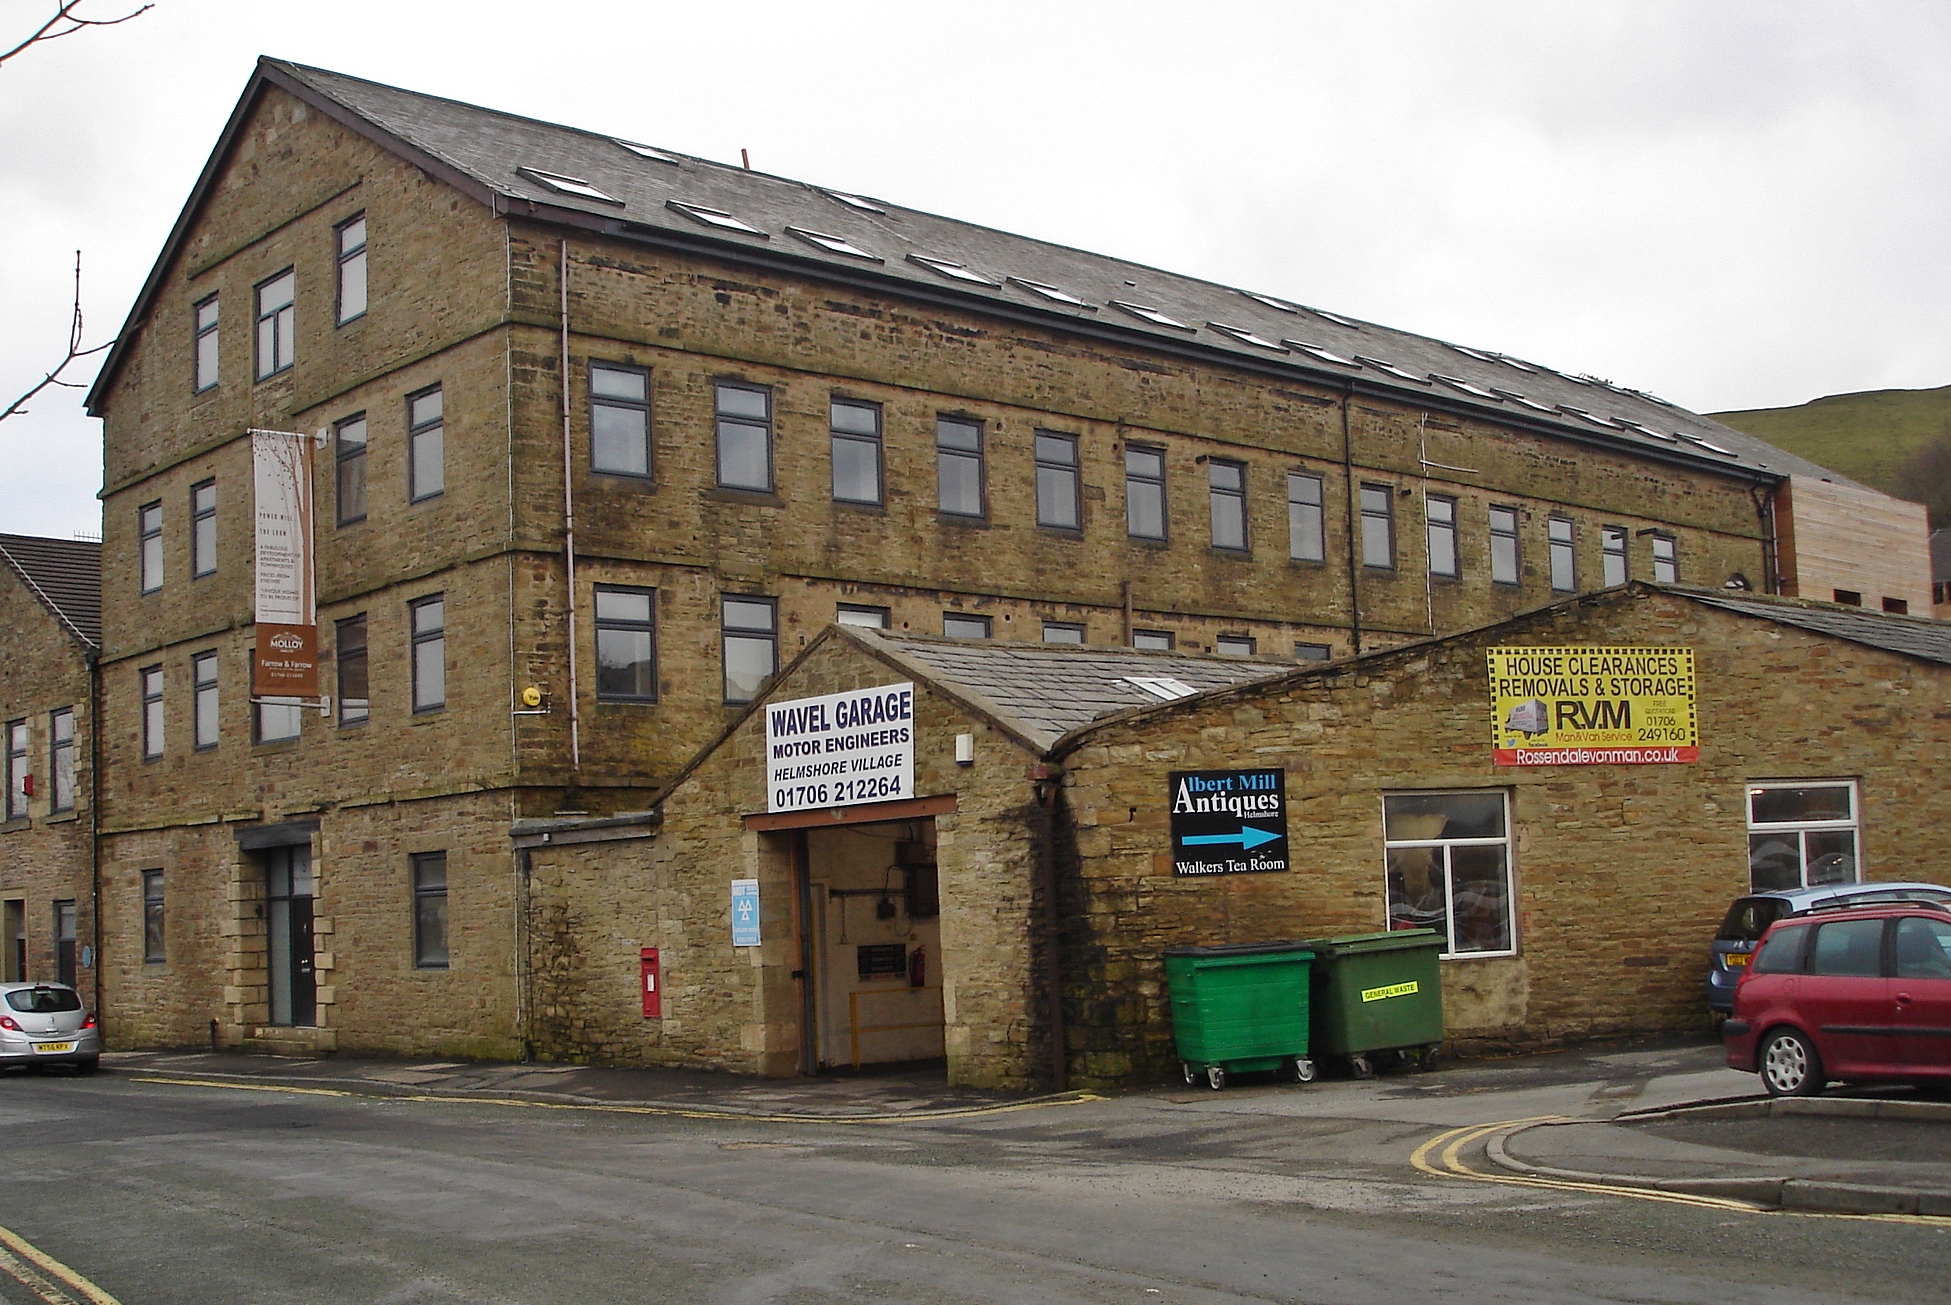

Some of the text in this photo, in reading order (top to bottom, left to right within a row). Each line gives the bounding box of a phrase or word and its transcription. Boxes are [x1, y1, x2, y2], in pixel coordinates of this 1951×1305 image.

[270, 639, 304, 649] MOLLOY
[261, 659, 313, 669] Farrow & Farrow
[1506, 656, 1678, 676] HOUSE CLEARANCES
[1500, 677, 1687, 697] REMOVALS & STORAGE
[772, 691, 911, 737] WAVEL GARAGE
[1646, 716, 1676, 727] 01706
[1602, 731, 1633, 742] Service
[1637, 727, 1686, 741] 249160
[773, 727, 910, 759] MOTOR ENGINEERS
[1516, 747, 1679, 765] Rossendalevanman.co.uk
[774, 753, 903, 782] HELMSHORE VILLAGE
[1239, 774, 1276, 790] Mill
[776, 775, 901, 808] 01706 212264
[1172, 777, 1279, 818] Antiques
[1244, 810, 1279, 818] Helmshore
[1176, 858, 1285, 874] Walkers Tea Room
[1365, 984, 1415, 999] GENERAL WASTE
